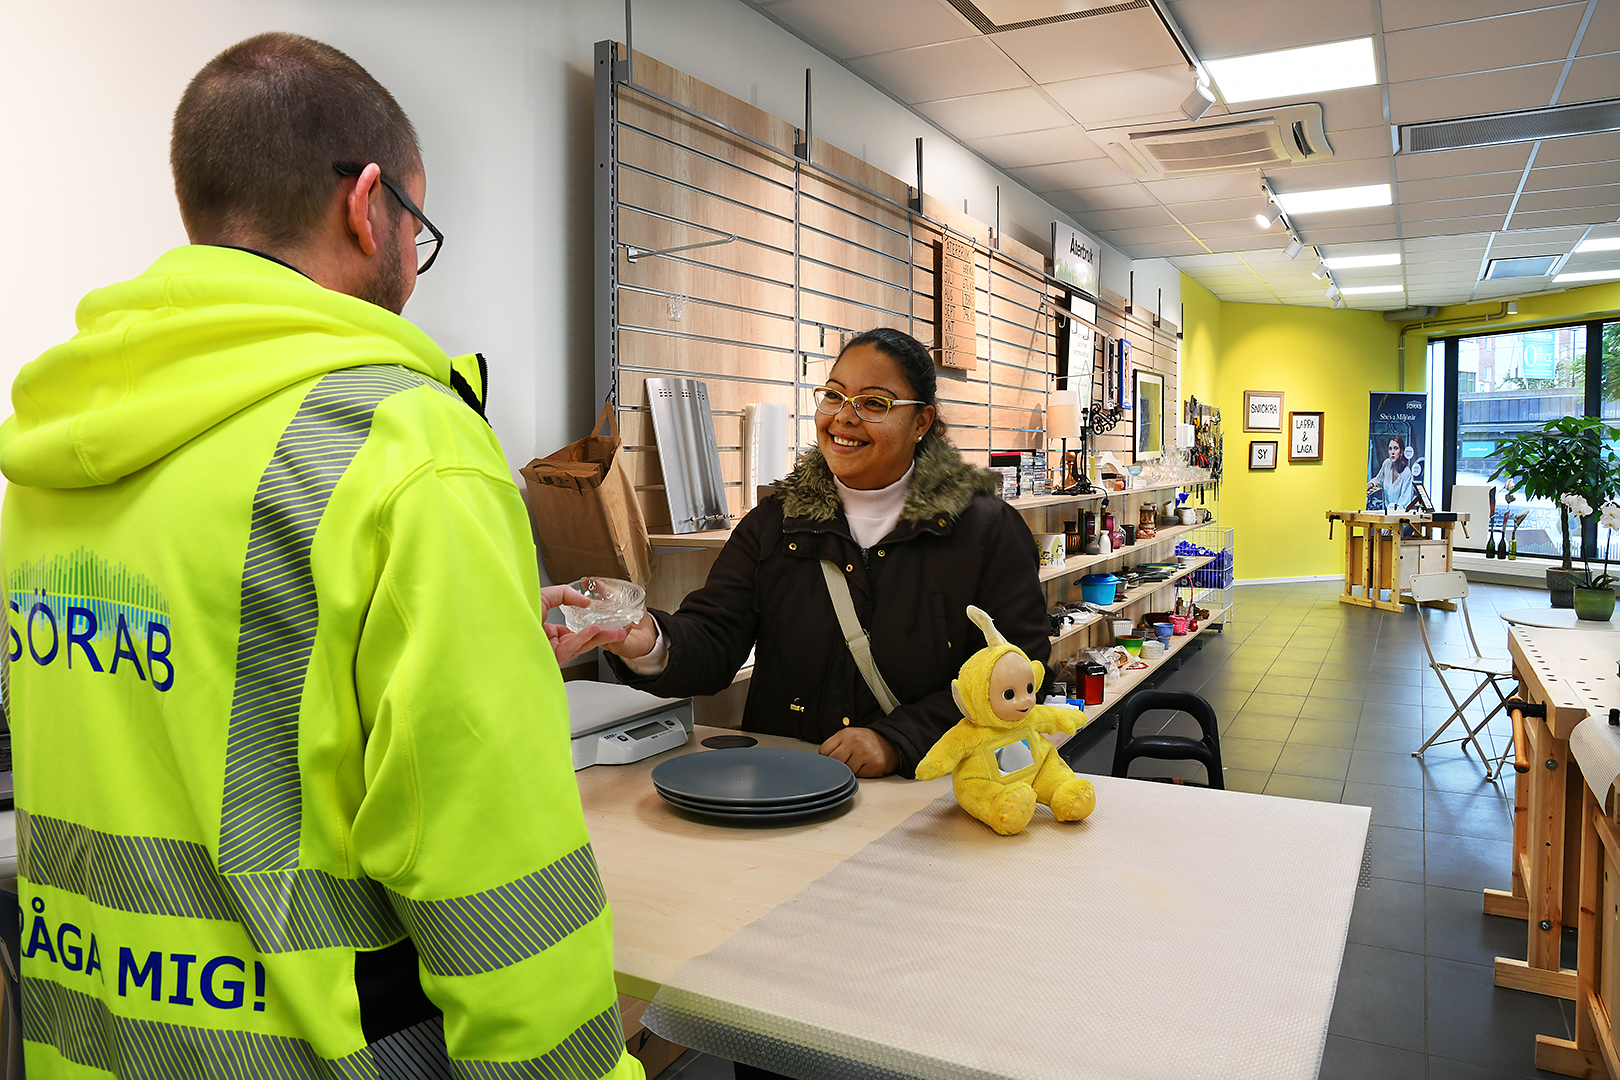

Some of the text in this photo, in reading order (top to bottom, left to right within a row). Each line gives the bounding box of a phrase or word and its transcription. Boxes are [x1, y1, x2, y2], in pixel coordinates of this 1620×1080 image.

[945, 350, 956, 366] DEC
[1250, 403, 1278, 414] SNICKRA
[1295, 419, 1315, 429] LAPPA
[1302, 431, 1308, 442] &
[1257, 448, 1268, 459] SY
[9, 588, 174, 692] SÖRAB
[18, 896, 265, 1012] ÅGA MIG!
